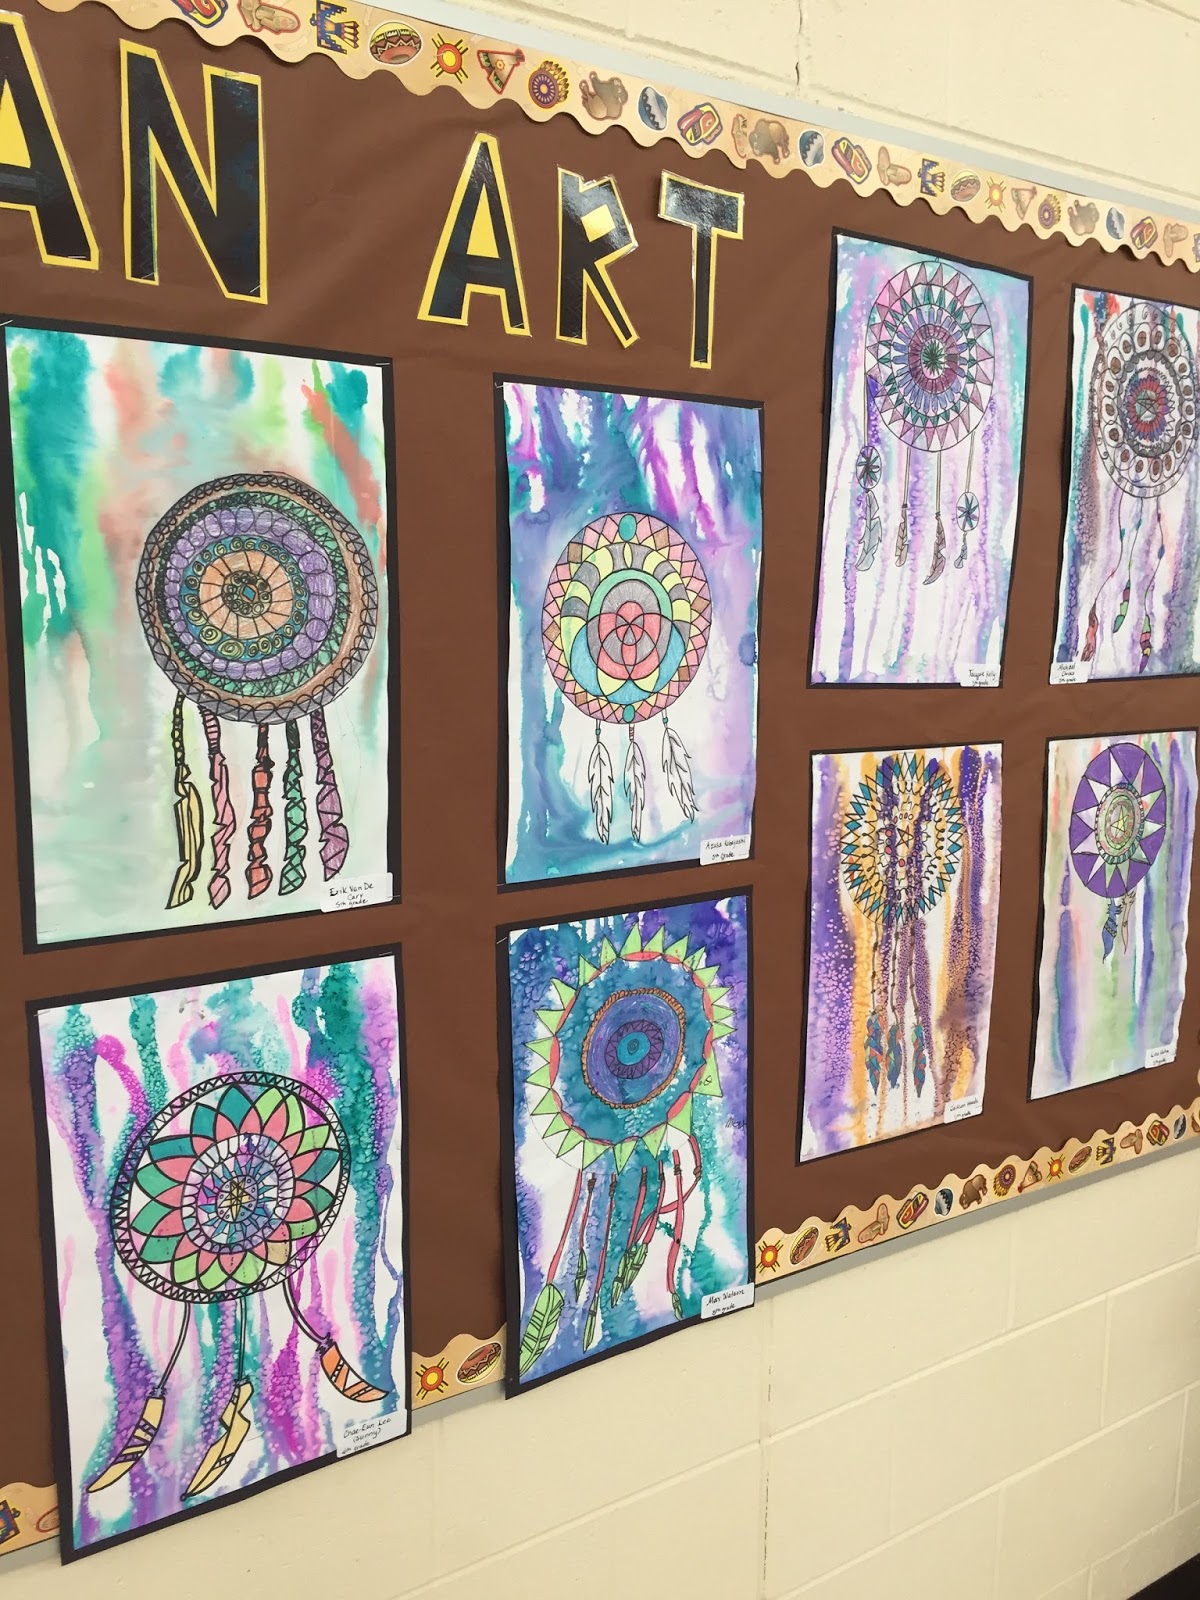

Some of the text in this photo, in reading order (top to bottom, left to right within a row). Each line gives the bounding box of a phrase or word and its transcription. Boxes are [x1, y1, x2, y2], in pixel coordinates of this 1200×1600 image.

[418, 132, 745, 370] ART
[329, 882, 374, 897] Erik Van De
[348, 898, 369, 908] grade
[377, 1418, 392, 1426] Lee
